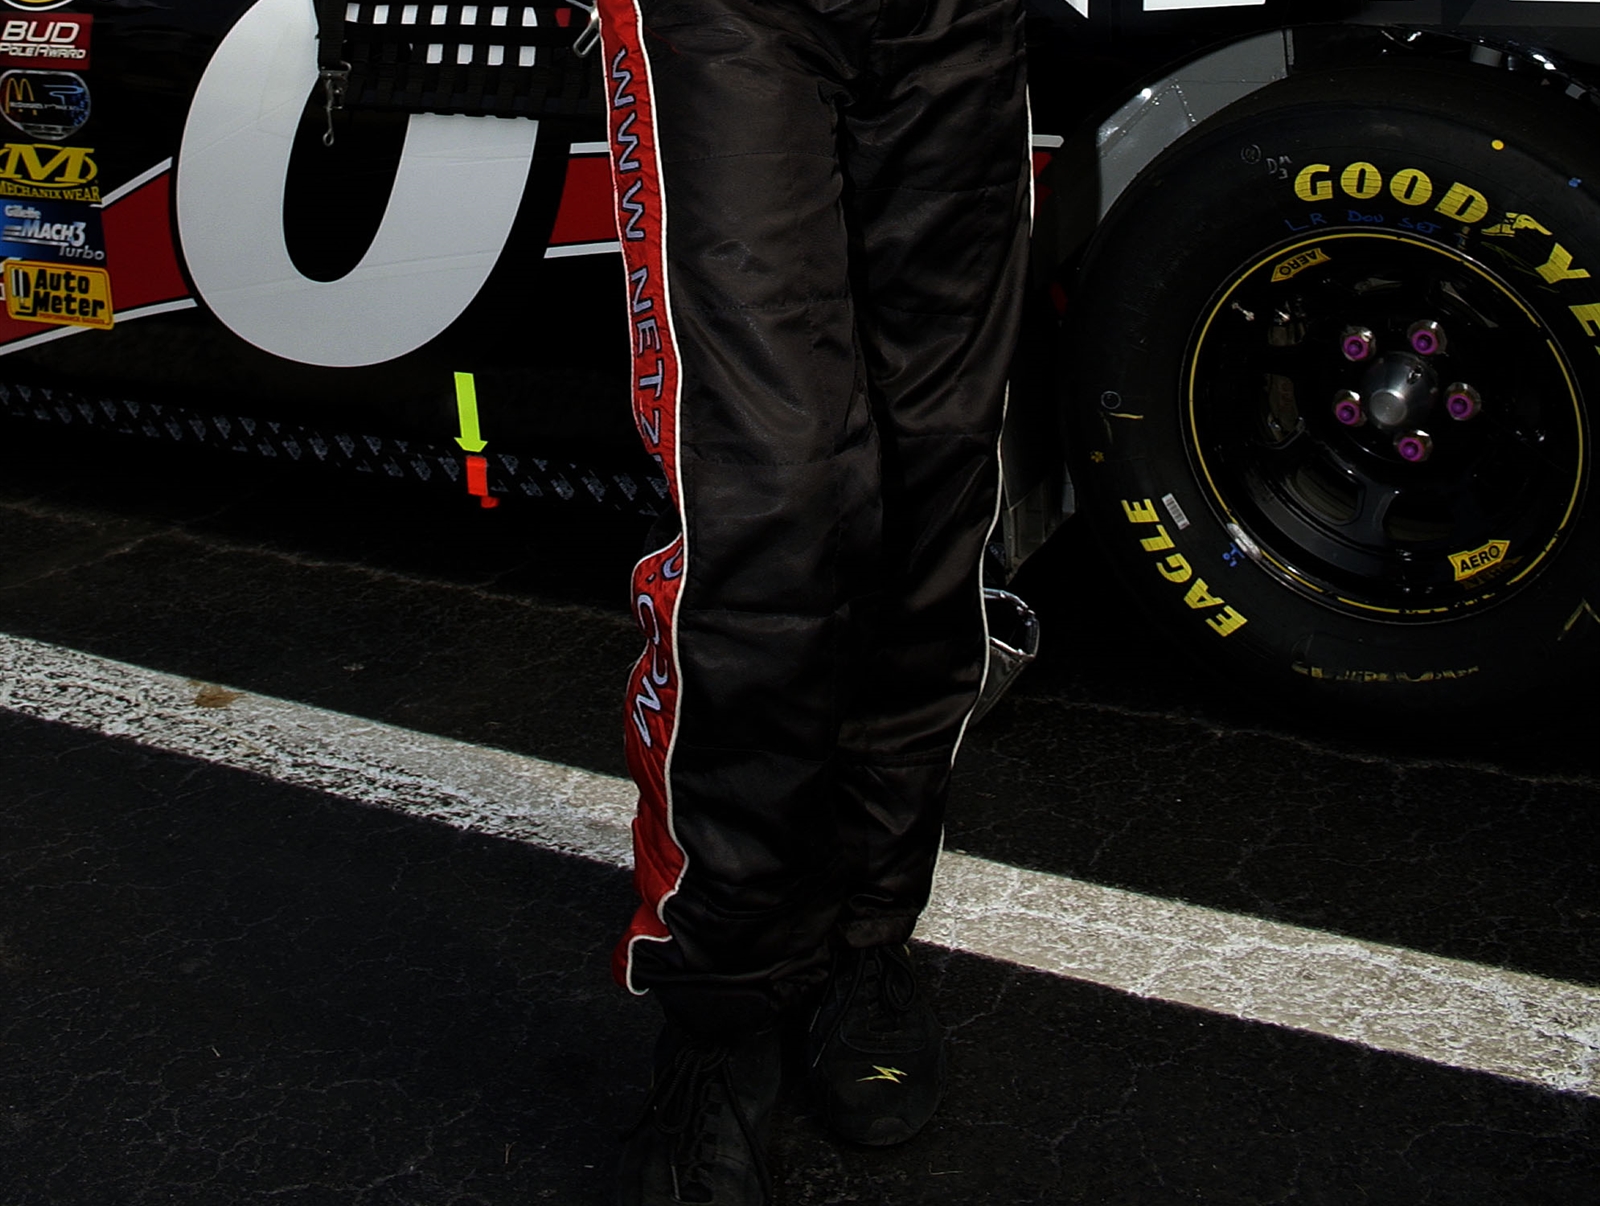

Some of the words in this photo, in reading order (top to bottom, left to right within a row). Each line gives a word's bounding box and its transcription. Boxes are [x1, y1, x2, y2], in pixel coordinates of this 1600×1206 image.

[1, 20, 80, 43] BUD
[0, 180, 62, 199] MECHANIX
[61, 186, 102, 203] WEAR
[59, 245, 105, 260] Turbo
[1279, 249, 1318, 276] AERO
[34, 268, 90, 295] Auto
[32, 290, 105, 316] Meter
[1121, 497, 1248, 638] EAGLE
[1459, 545, 1502, 575] AERO
